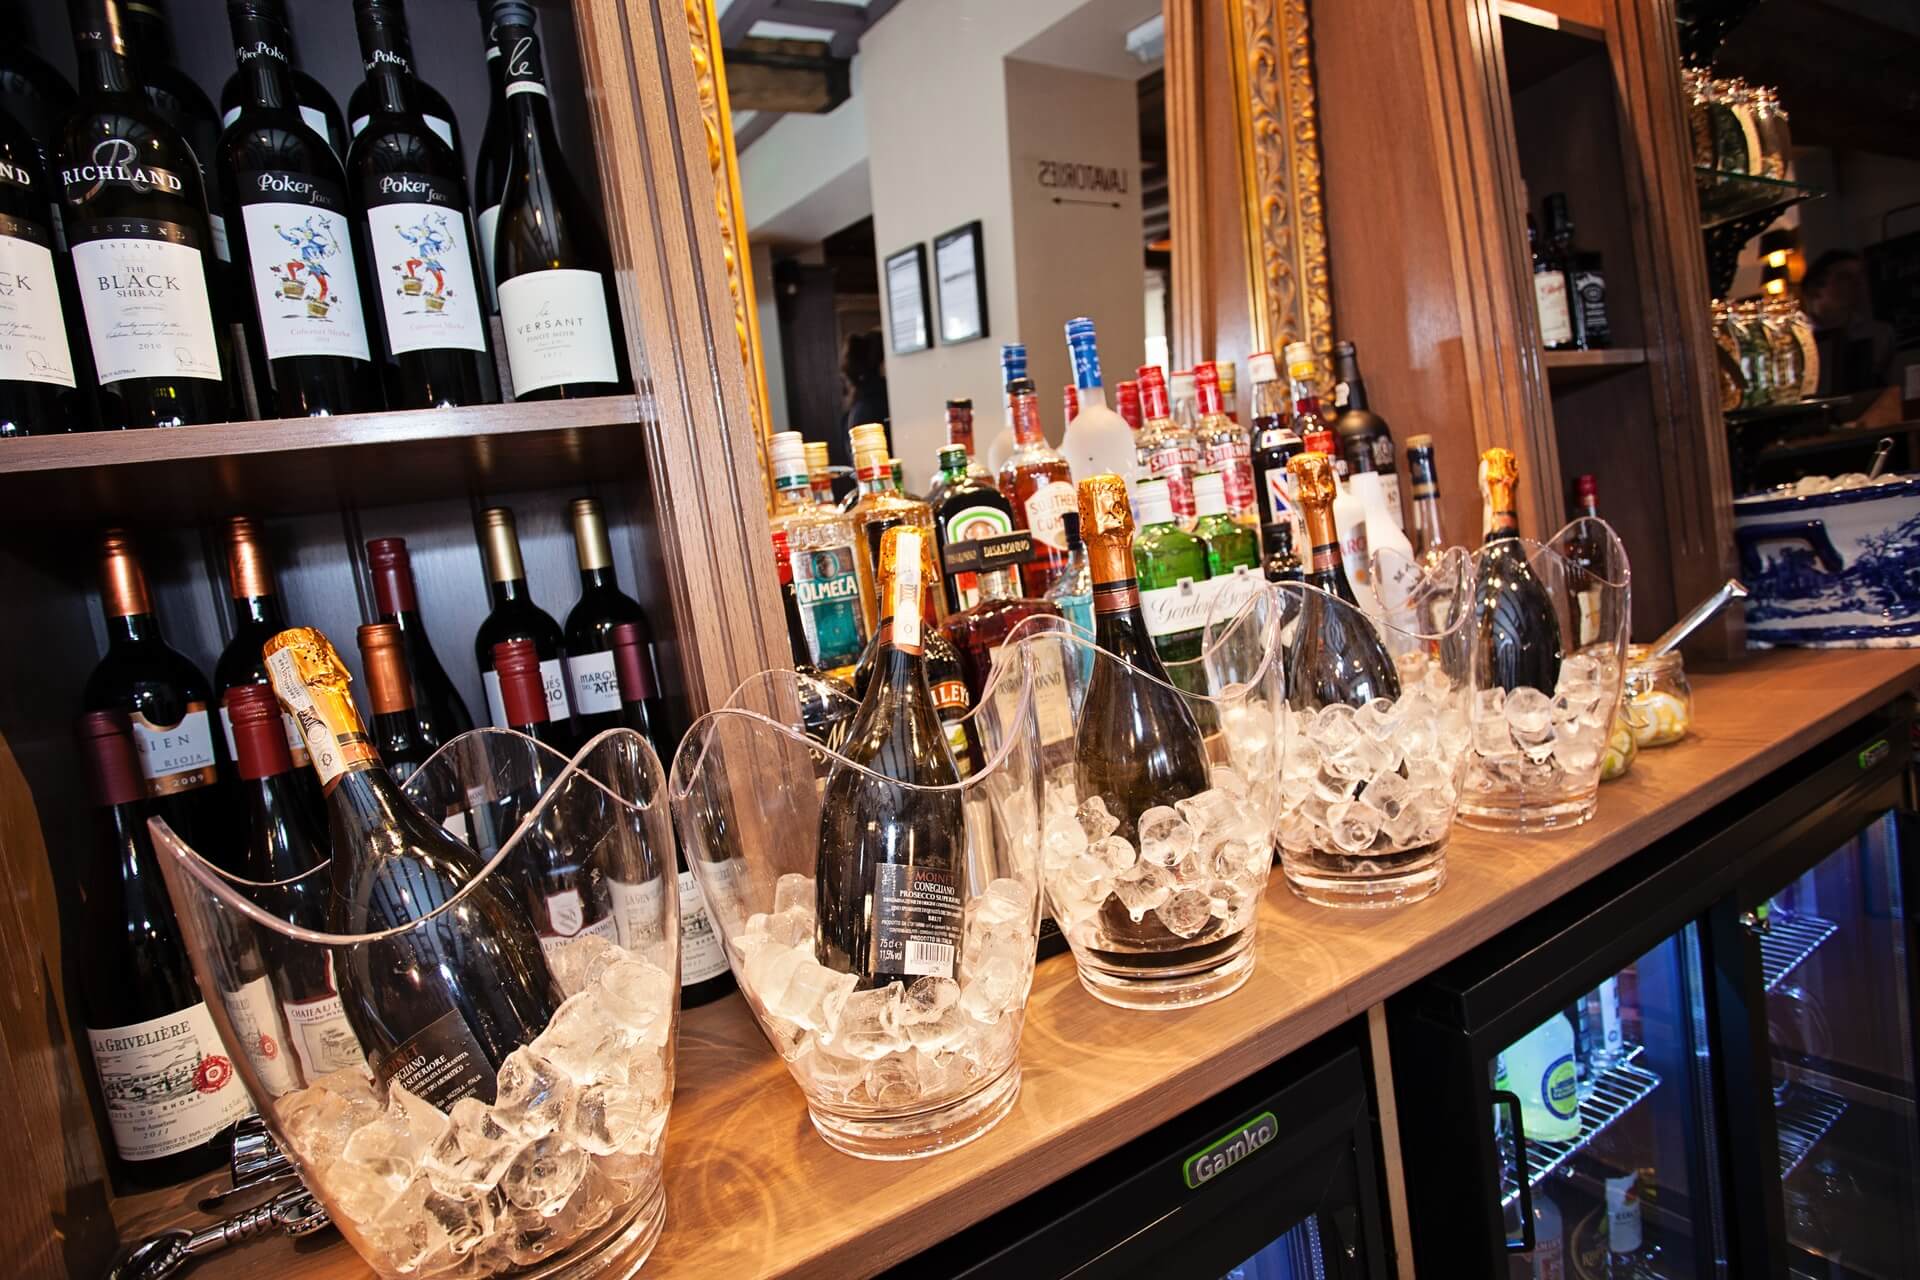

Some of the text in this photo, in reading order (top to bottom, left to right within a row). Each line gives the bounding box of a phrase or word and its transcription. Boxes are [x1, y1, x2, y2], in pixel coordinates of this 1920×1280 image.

[62, 165, 182, 190] RICHLAND
[257, 172, 313, 194] Poker
[380, 176, 430, 193] Poker
[98, 274, 181, 291] BLACK
[116, 289, 164, 298] SHIRAZ
[517, 318, 584, 335] VERSANT
[799, 576, 858, 602] OLMECA
[164, 754, 203, 767] RIOJA
[173, 774, 204, 787] 2009
[899, 890, 936, 900] PROSECCO
[913, 881, 955, 896] CONEGLIANO
[880, 939, 887, 948] 75
[105, 1020, 192, 1052] GRIVELIÈRE
[407, 1054, 448, 1088] SUPERIORE
[140, 1109, 154, 1117] DU
[143, 1128, 170, 1139] 2011
[1196, 1126, 1271, 1182] Gamko
